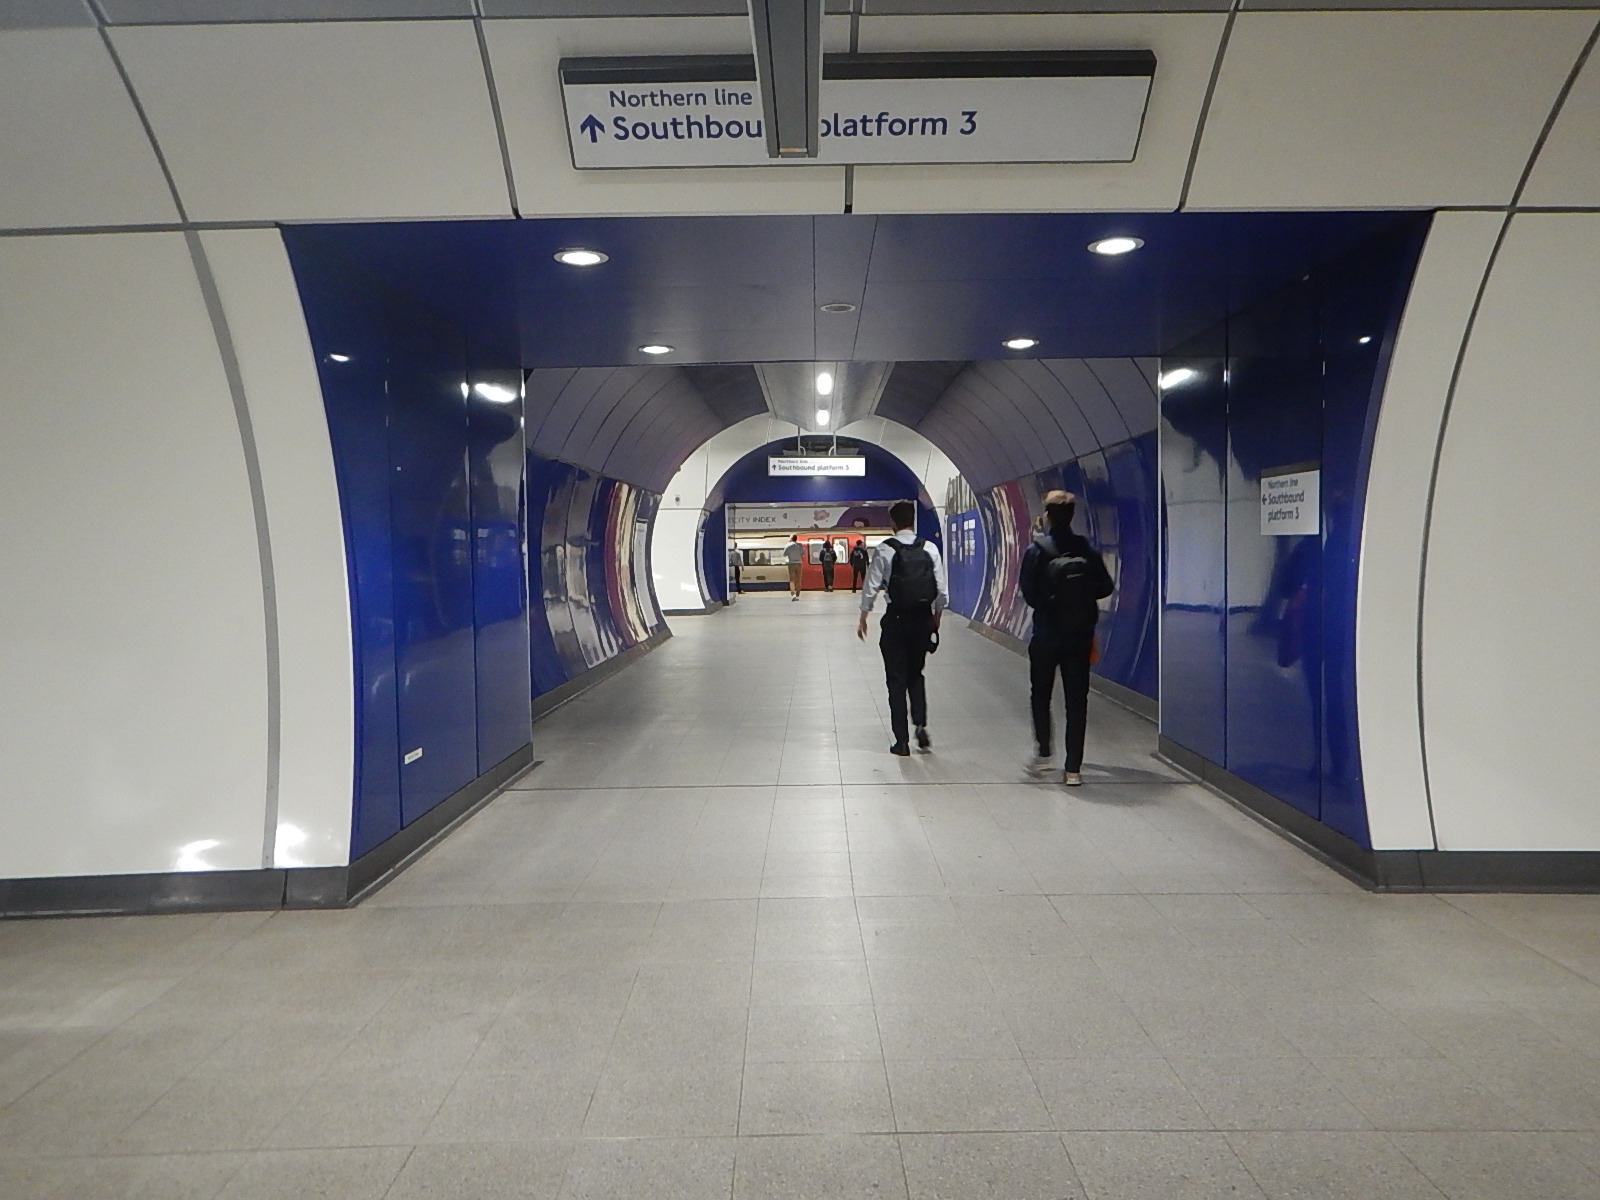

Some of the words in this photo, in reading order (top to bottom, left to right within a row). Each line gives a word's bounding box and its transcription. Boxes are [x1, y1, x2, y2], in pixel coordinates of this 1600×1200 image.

[609, 89, 707, 108] Northern
[714, 88, 753, 106] line
[613, 114, 764, 141] Southbou
[959, 110, 978, 136] 3
[1268, 490, 1305, 505] Southbound
[752, 515, 776, 523] INDEX
[1267, 508, 1294, 523] platform
[1295, 506, 1300, 520] 3
